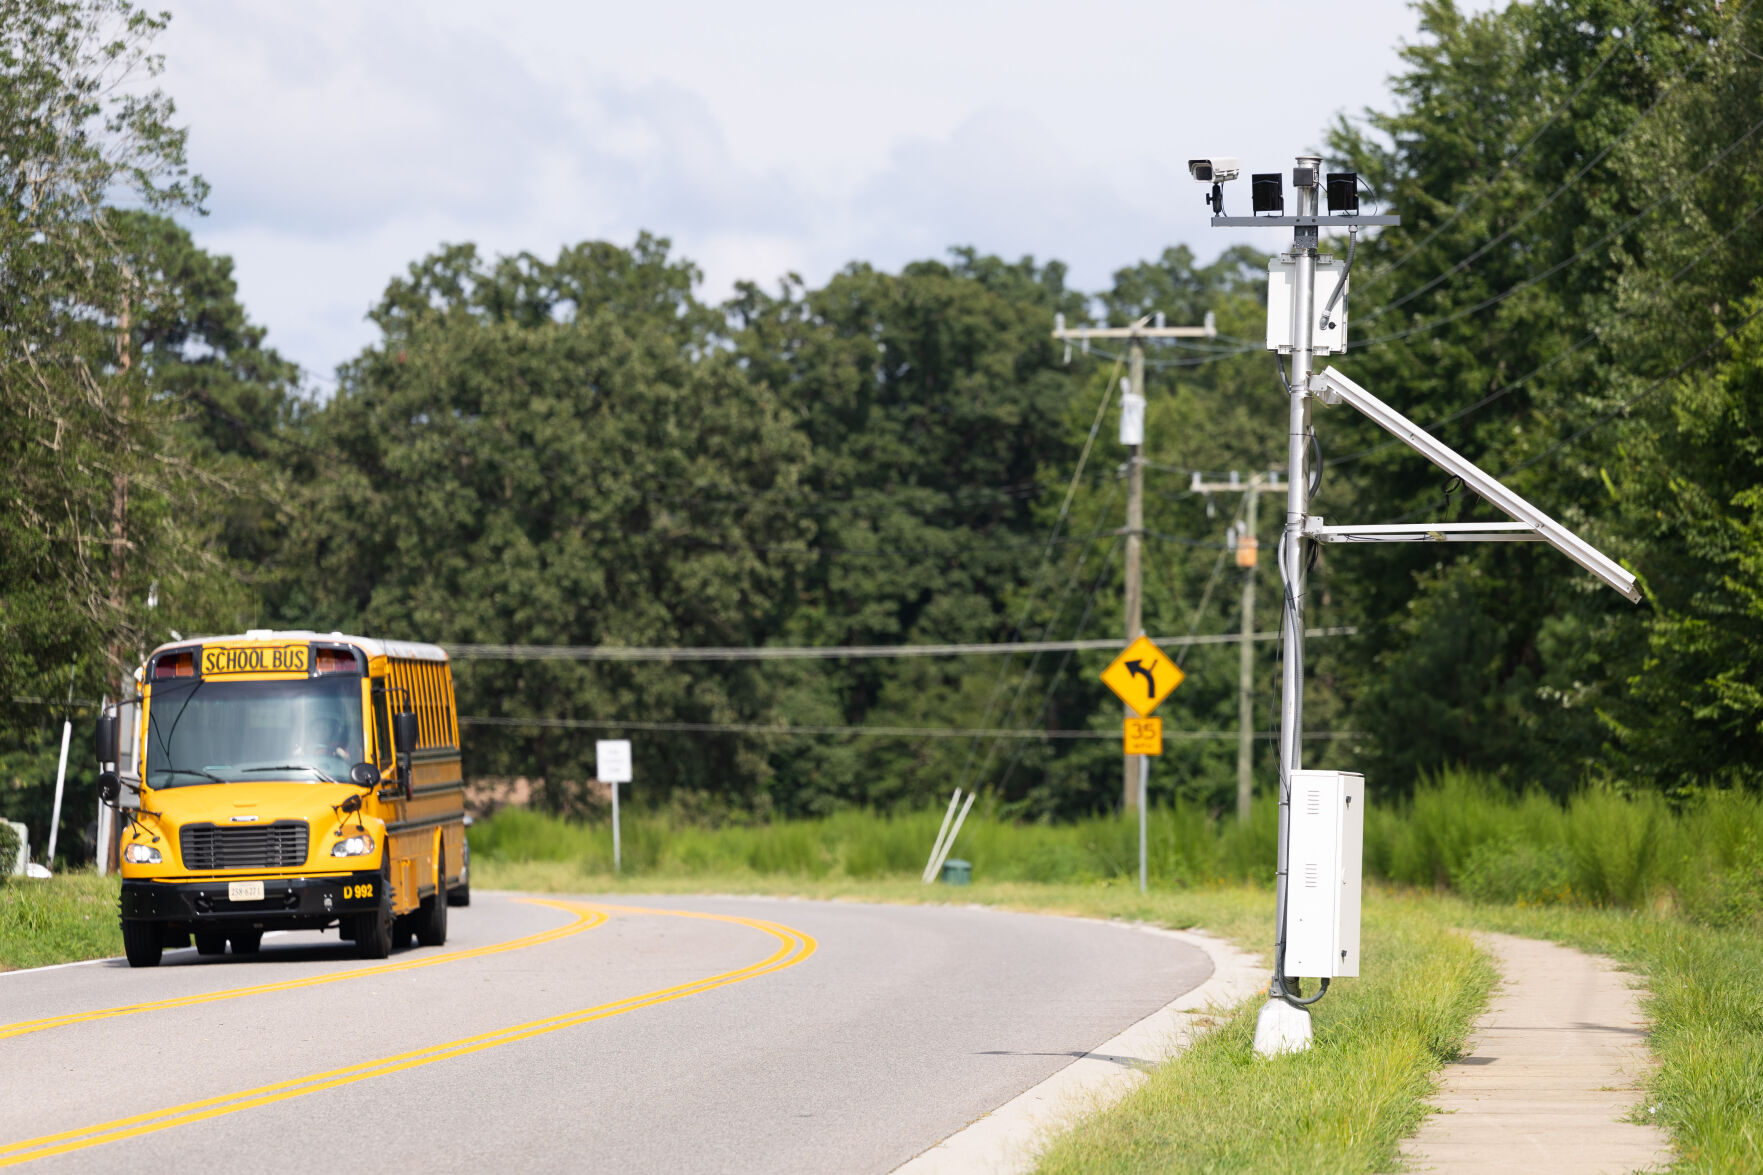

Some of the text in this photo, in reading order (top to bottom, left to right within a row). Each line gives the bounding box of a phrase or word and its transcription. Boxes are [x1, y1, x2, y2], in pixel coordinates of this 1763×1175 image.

[205, 650, 304, 672] SCHOOL BUS
[1131, 723, 1156, 740] 35
[344, 883, 373, 899] D 992
